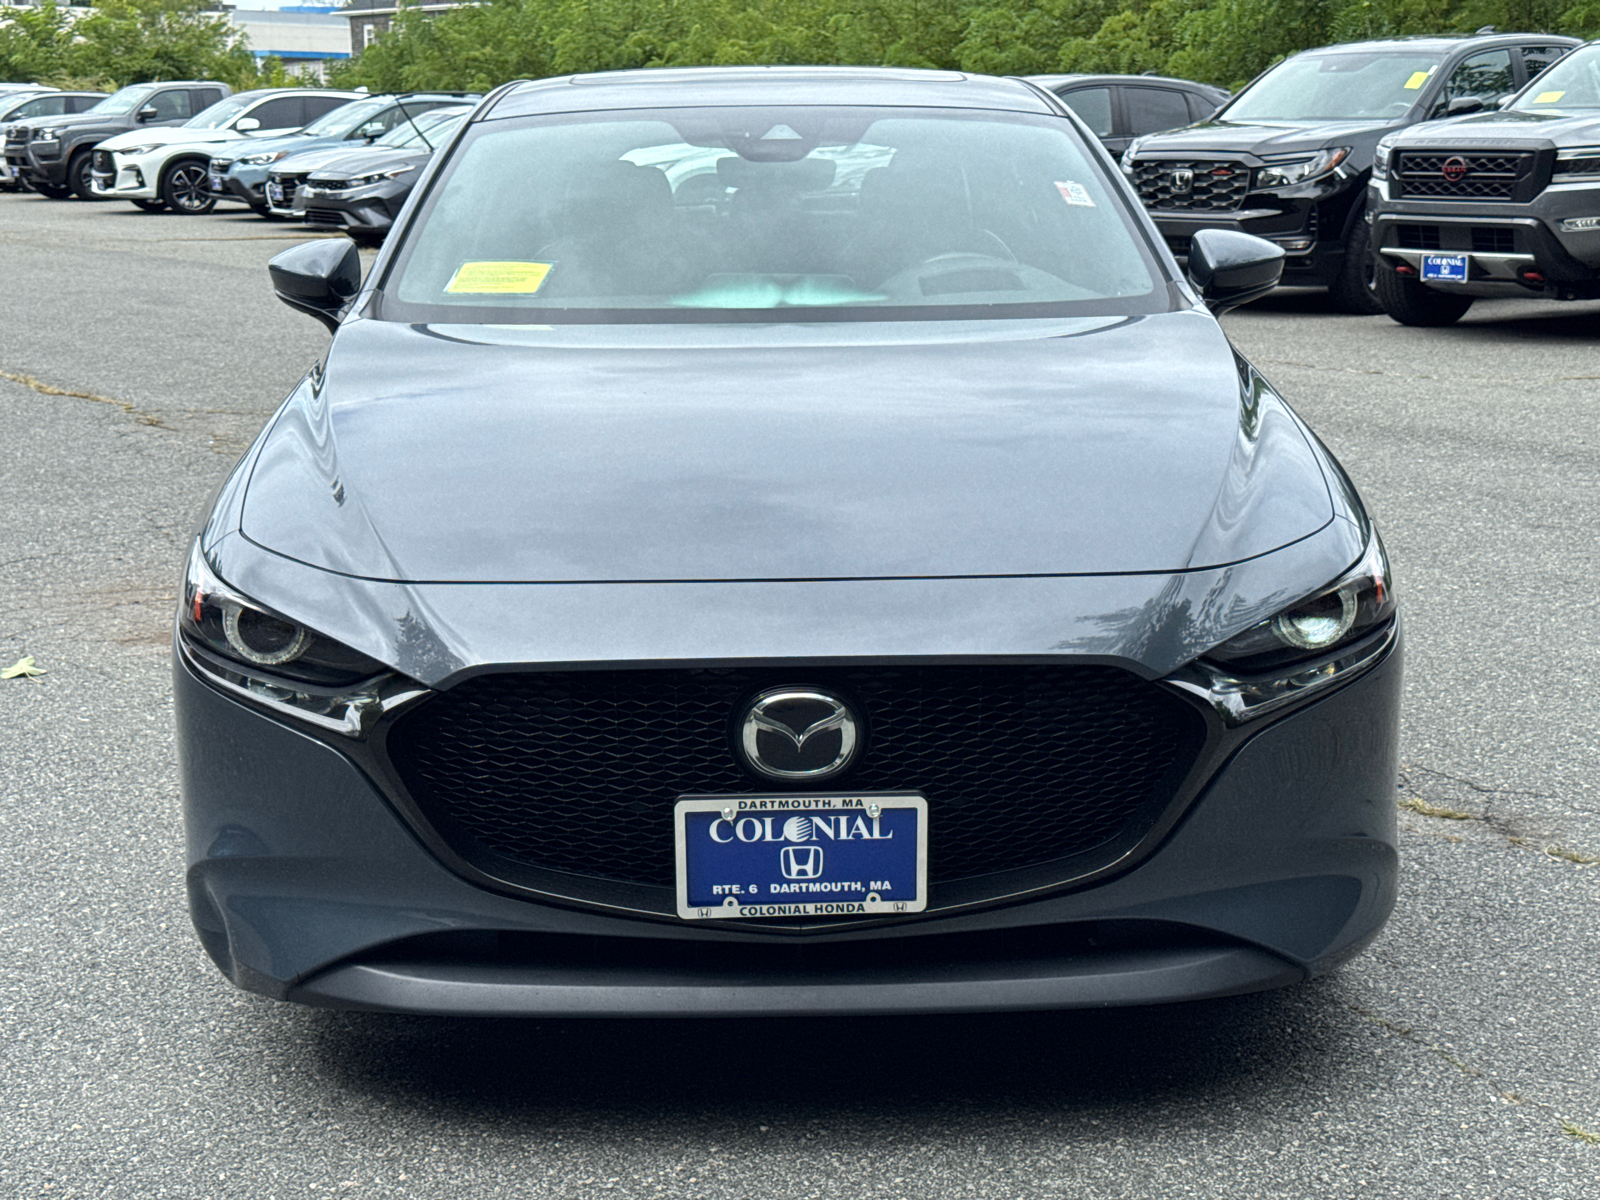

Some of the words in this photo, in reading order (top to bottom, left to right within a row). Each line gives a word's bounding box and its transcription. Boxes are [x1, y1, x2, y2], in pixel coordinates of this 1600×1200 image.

[738, 799, 837, 810] DARTMOUTH,
[842, 798, 864, 808] MA
[709, 815, 893, 843] COLONIAL
[712, 884, 745, 895] RTE.
[748, 884, 758, 894] 6
[770, 881, 866, 894] DARTMOUTH,
[869, 880, 892, 891] MA
[739, 904, 810, 917] COLONIAL
[814, 903, 866, 914] HONDA
